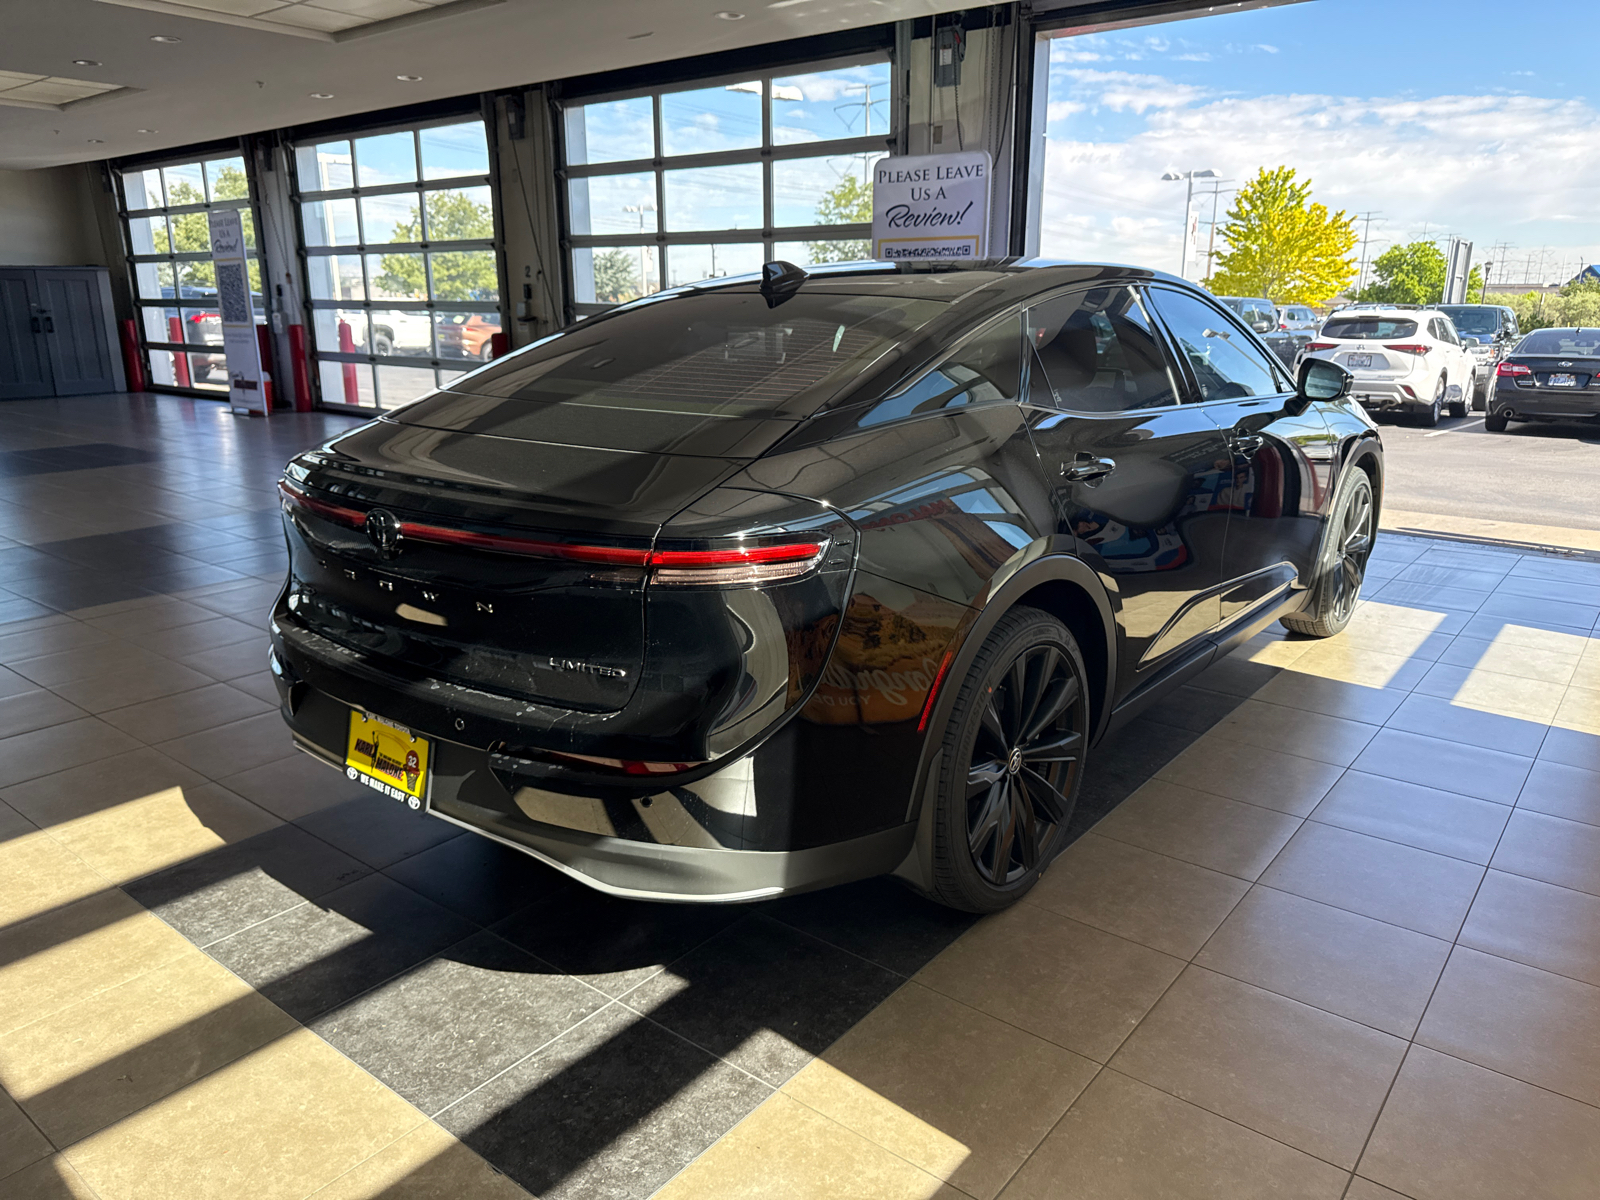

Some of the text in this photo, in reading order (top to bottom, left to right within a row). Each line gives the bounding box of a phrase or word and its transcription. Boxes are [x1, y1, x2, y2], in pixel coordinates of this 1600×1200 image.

[879, 164, 984, 184] PLEASE LEAVE
[935, 186, 947, 200] A
[885, 200, 974, 228] Review!
[525, 265, 531, 278] 2
[549, 657, 628, 678] LIMITED
[354, 738, 374, 758] KARL
[408, 755, 417, 768] 32
[360, 773, 406, 802] WE MAKE IT EASY
